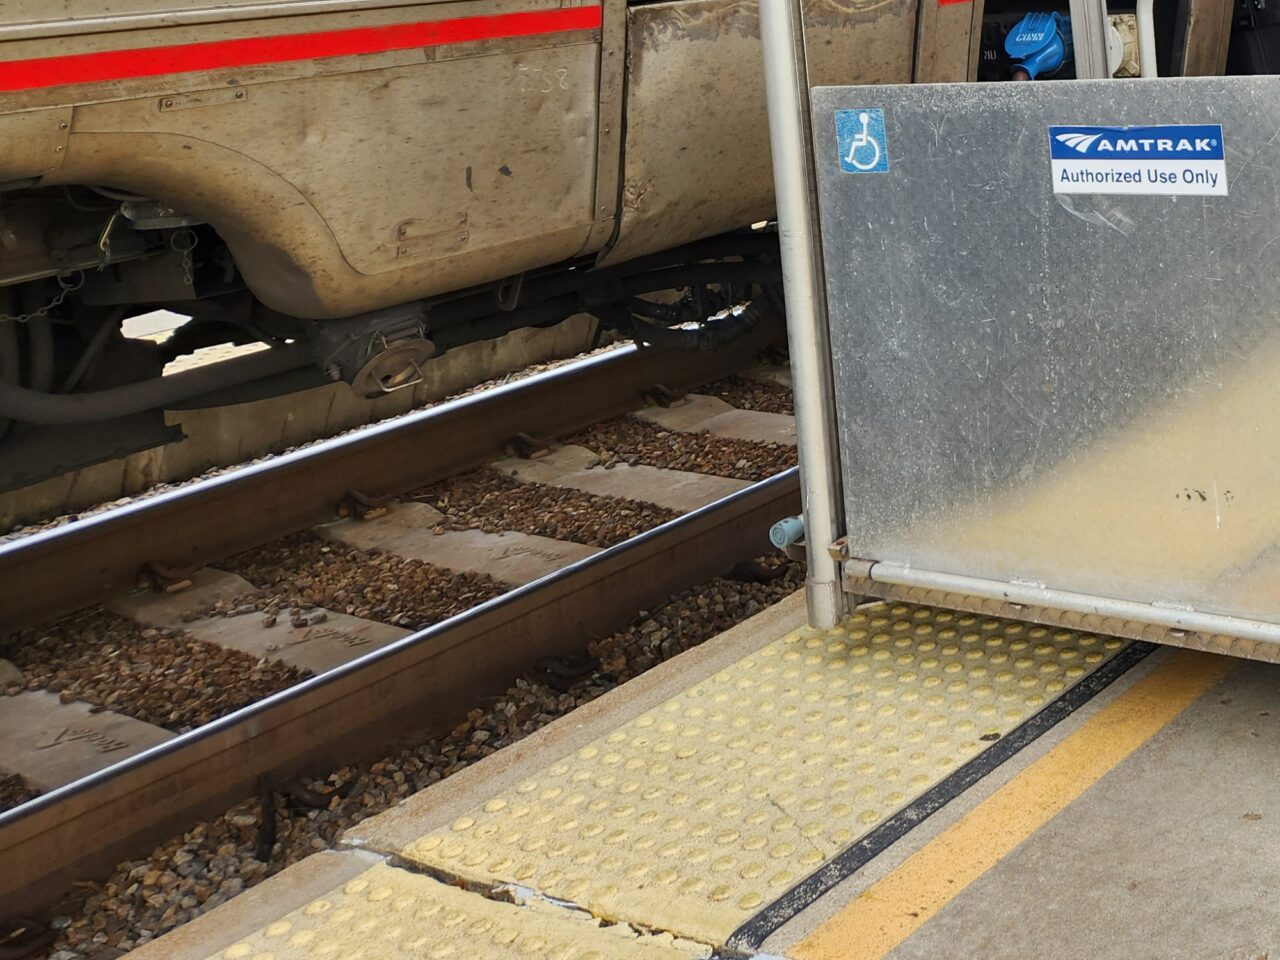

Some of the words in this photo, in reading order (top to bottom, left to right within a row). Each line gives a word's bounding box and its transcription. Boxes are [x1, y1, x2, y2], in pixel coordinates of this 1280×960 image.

[1060, 168, 1142, 183] Authorized
[1147, 168, 1178, 184] Use
[1182, 168, 1218, 188] Only
